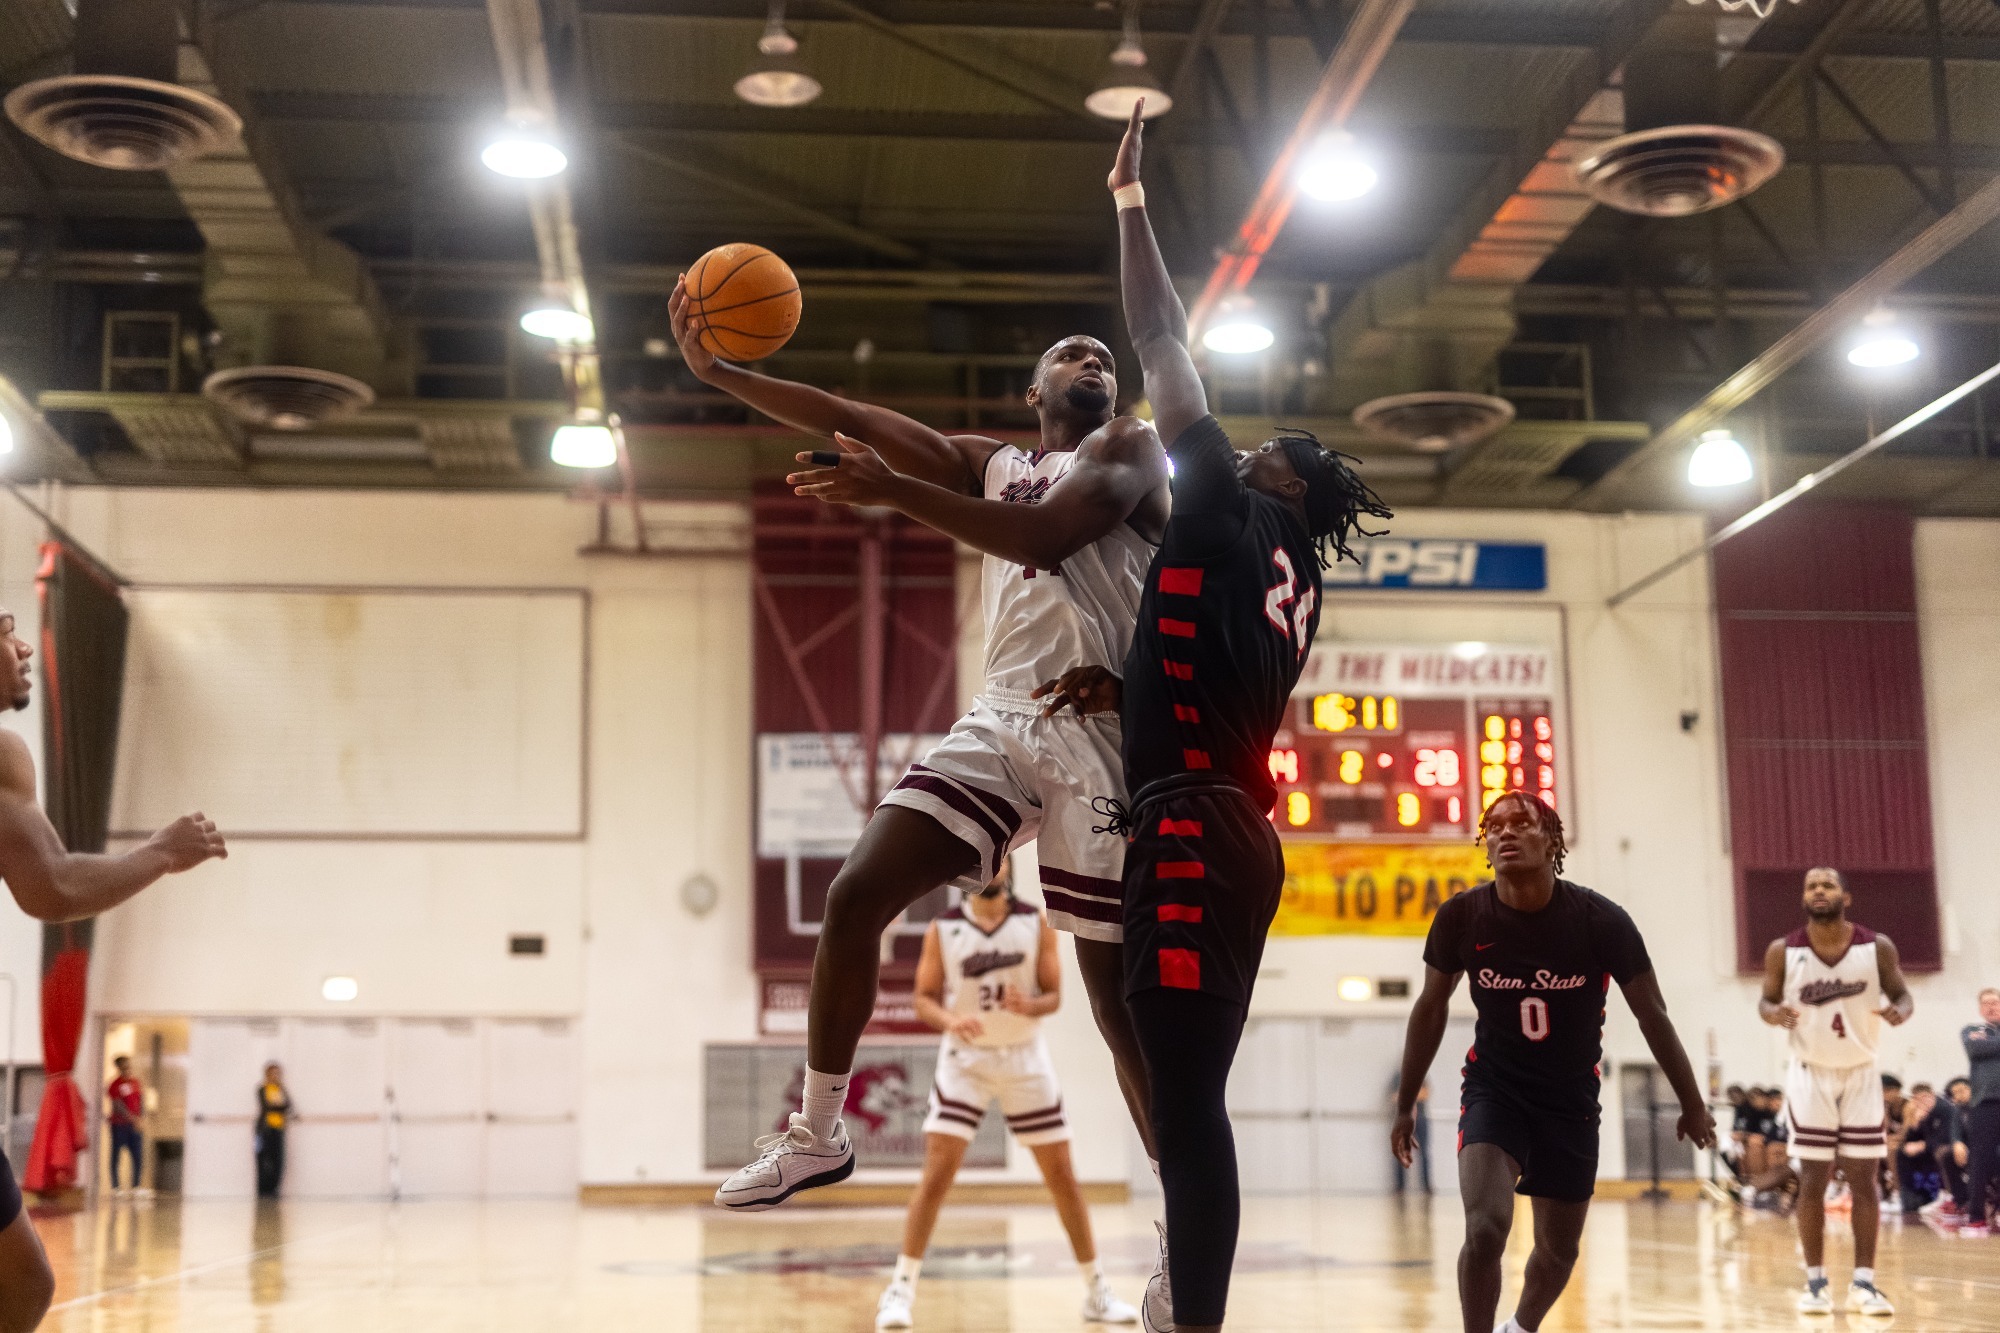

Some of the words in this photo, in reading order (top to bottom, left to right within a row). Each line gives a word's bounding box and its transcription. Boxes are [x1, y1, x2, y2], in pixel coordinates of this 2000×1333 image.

[1325, 540, 1478, 584] EPSI
[1337, 653, 1386, 683] THE
[1340, 751, 1364, 784] 2
[1414, 749, 1460, 786] 28
[1334, 872, 1377, 919] TO
[1394, 872, 1492, 918] PA
[1478, 968, 1525, 989] Stan
[1530, 969, 1586, 990] State
[1520, 997, 1550, 1041] 0
[1831, 1012, 1846, 1038] 4
